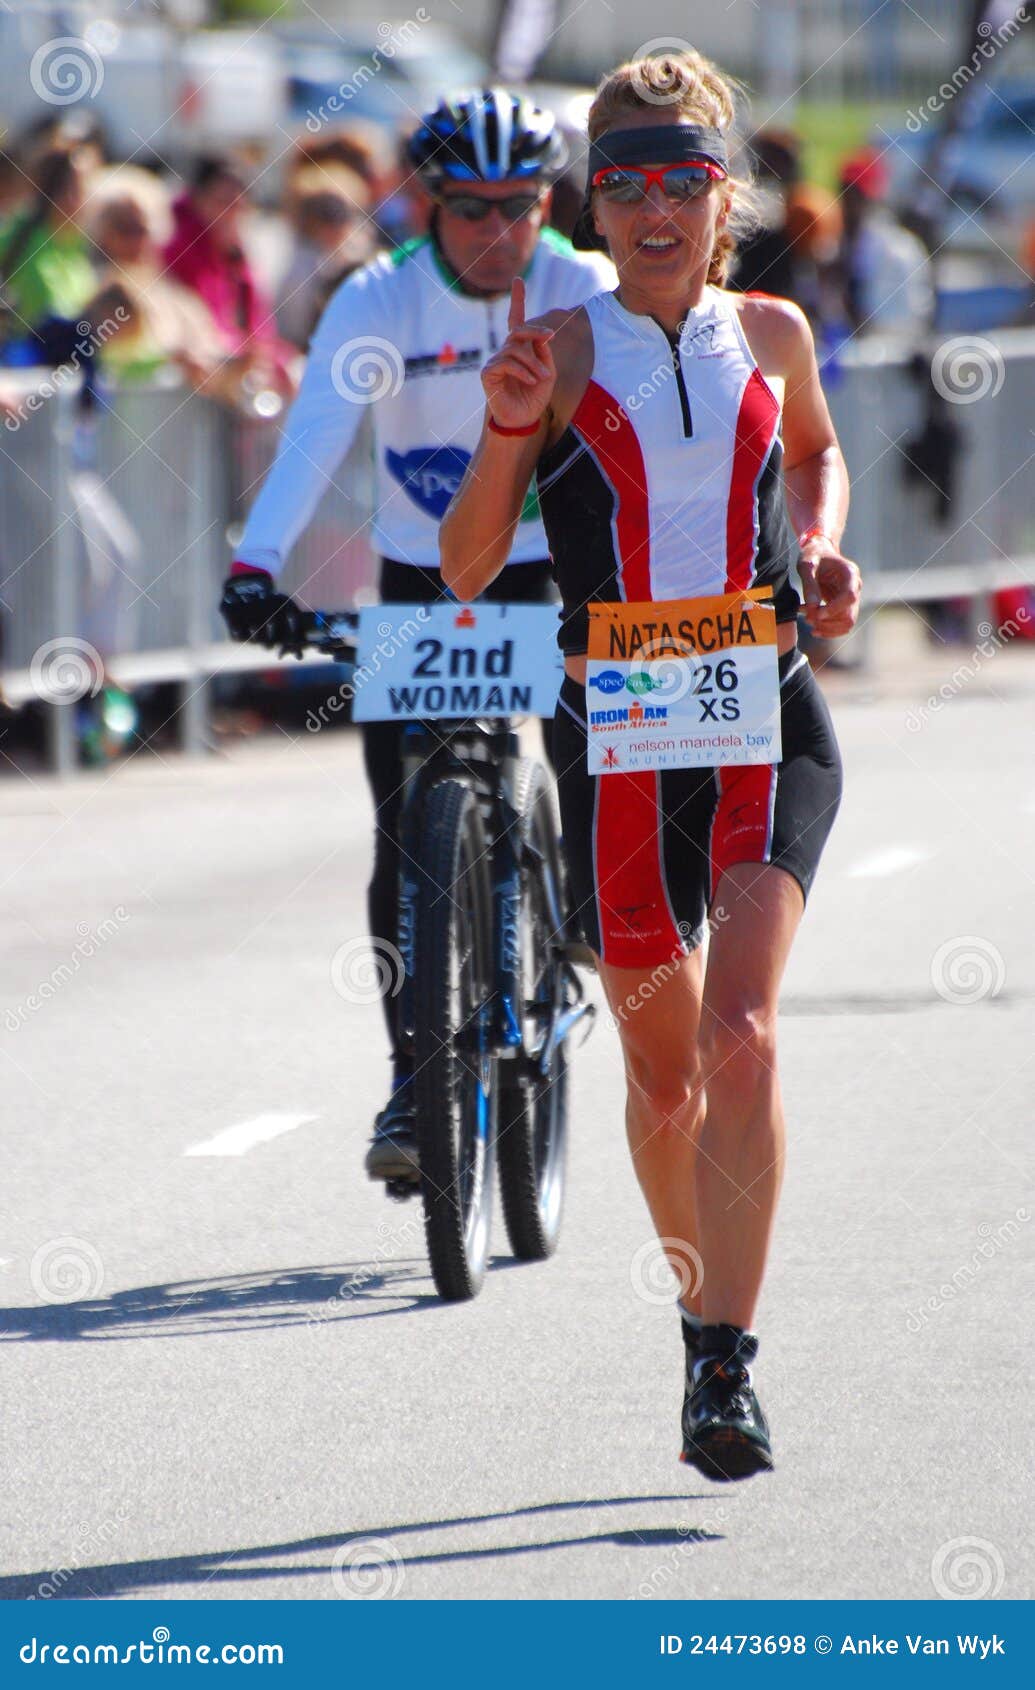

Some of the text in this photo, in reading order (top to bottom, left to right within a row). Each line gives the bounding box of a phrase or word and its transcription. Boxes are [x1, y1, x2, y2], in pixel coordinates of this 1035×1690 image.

[609, 611, 756, 659] NATASCHA
[412, 638, 514, 679] 2nd
[692, 659, 738, 696] 26
[388, 684, 532, 714] WOMAN
[698, 697, 740, 723] XS
[590, 701, 668, 725] IRONMAN
[591, 722, 626, 733] South
[629, 734, 773, 753] nelson mandela bay
[628, 750, 773, 767] MUNICIPALITY
